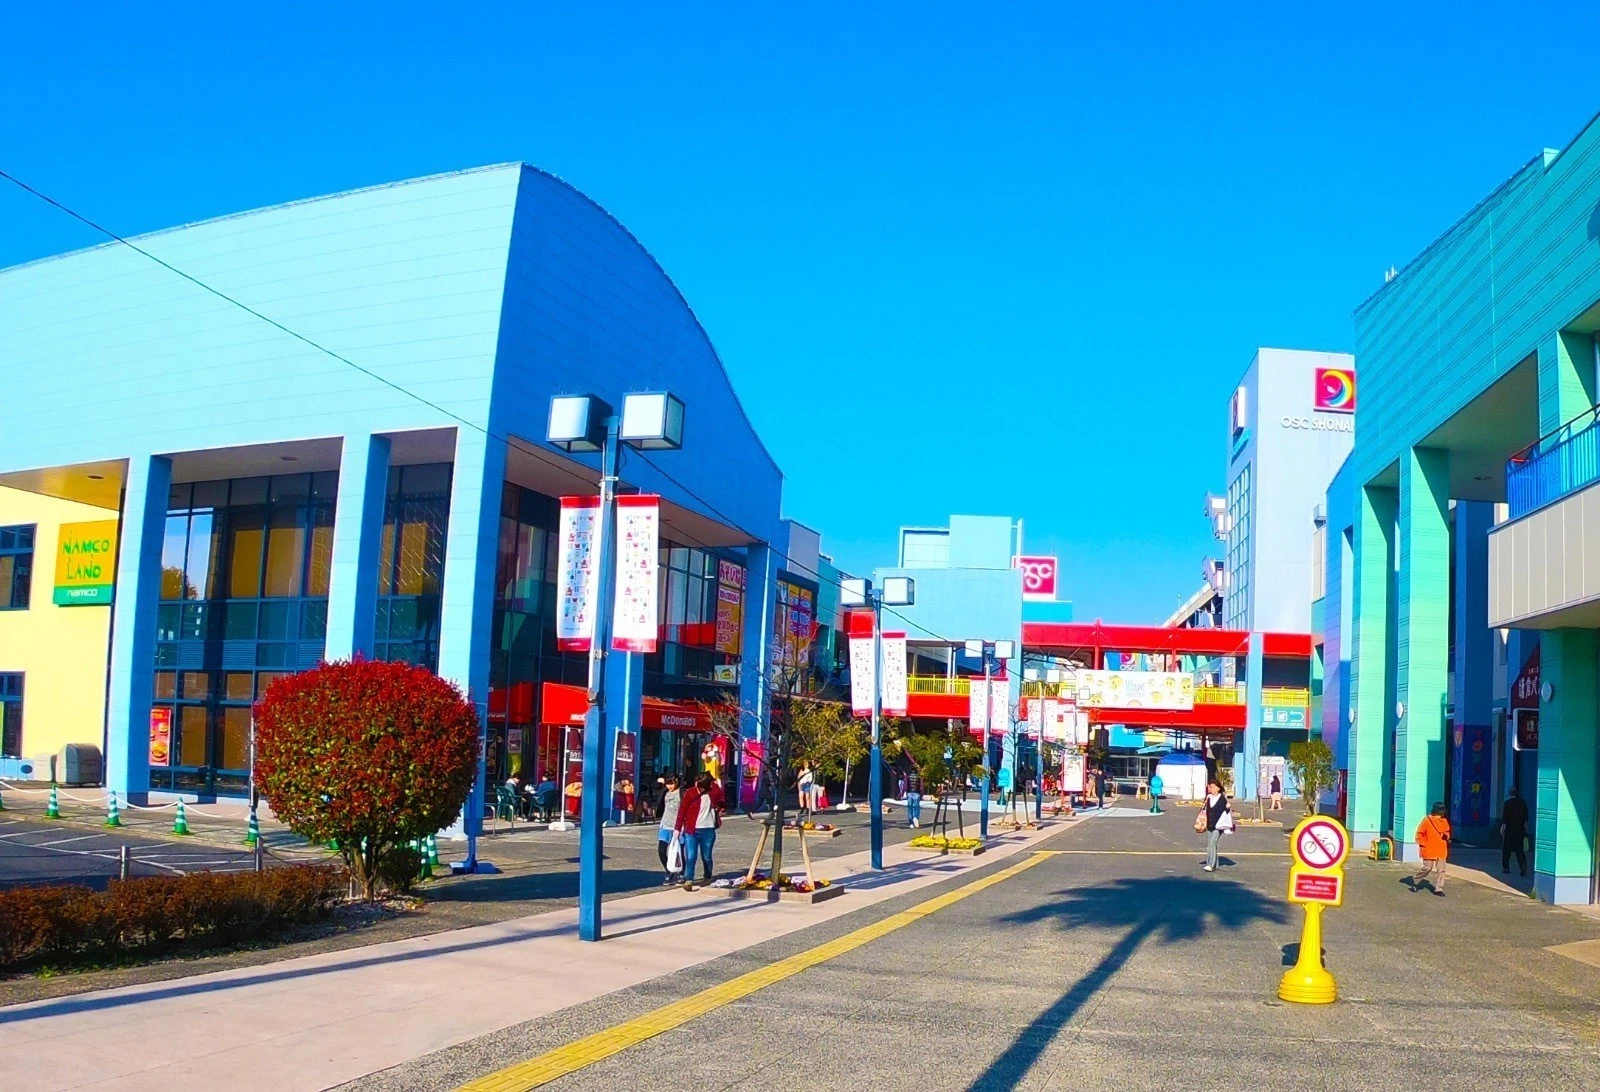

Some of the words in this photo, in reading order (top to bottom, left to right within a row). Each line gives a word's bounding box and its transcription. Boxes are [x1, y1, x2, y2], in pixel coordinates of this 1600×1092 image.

[1281, 416, 1310, 430] OSC
[62, 537, 110, 555] NAMCO
[66, 556, 101, 580] LAND
[661, 714, 696, 727] McDonald's
